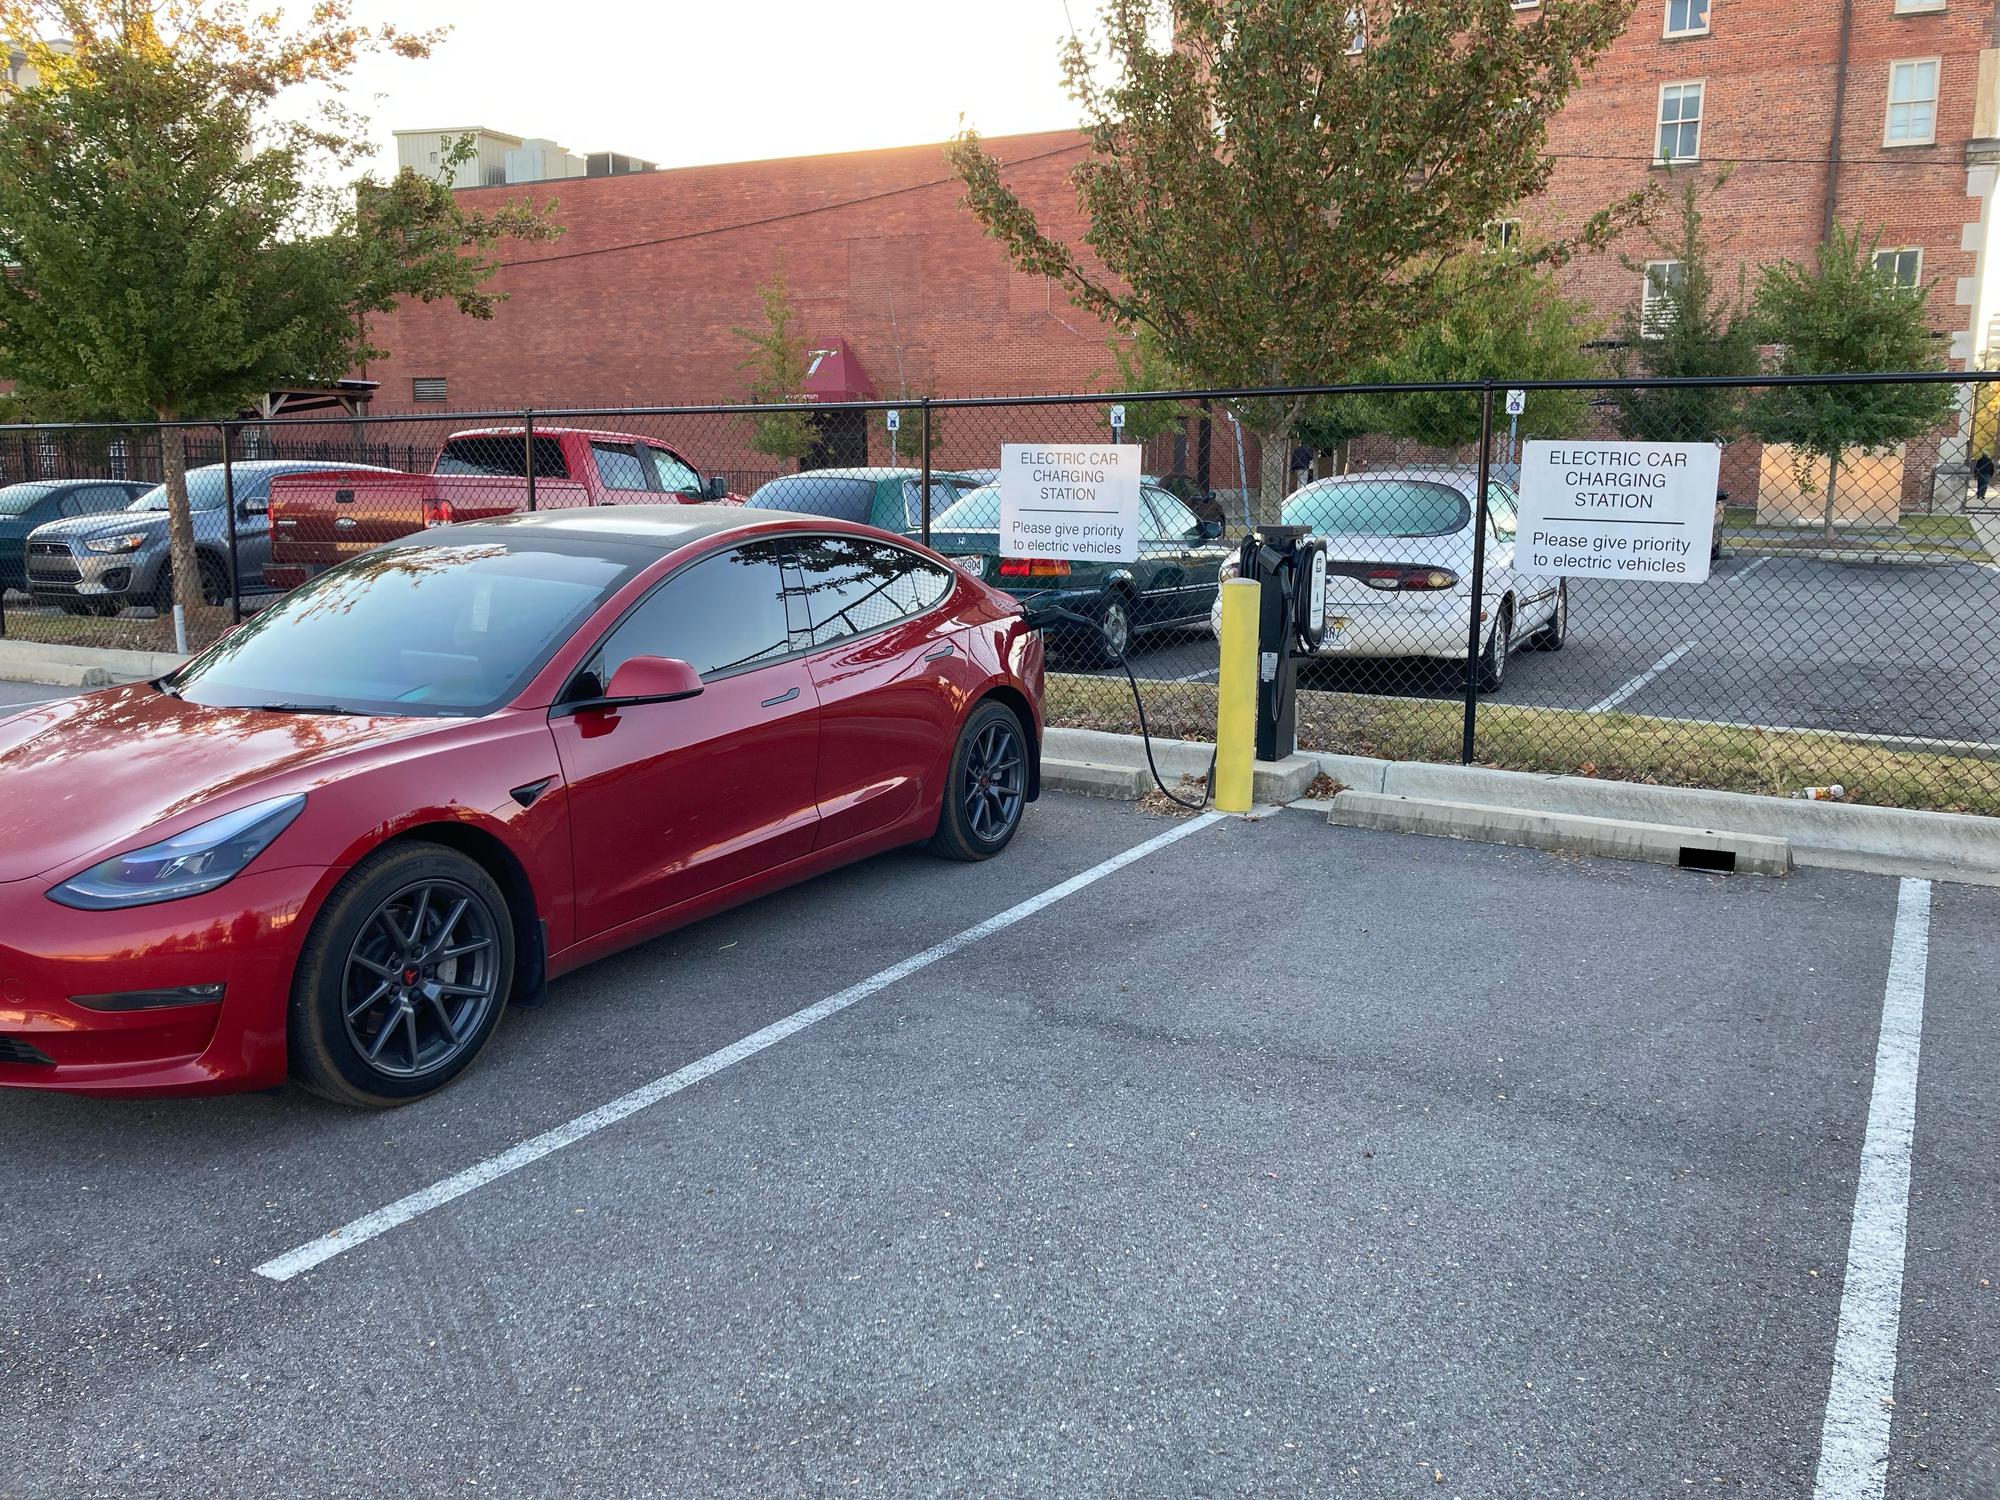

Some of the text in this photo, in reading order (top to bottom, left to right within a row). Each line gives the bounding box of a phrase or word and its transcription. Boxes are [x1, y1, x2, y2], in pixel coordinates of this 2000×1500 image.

[1021, 452, 1119, 465] ELECTRIC CAR
[1549, 450, 1687, 467] ELECTRIC CAR
[1033, 470, 1104, 483] CHARGING
[1565, 471, 1666, 488] CHARGING
[1040, 487, 1096, 501] STATION
[1574, 492, 1653, 508] STATION
[1012, 521, 1124, 540] Please give priority
[1013, 539, 1121, 555] to electric vehicles
[1533, 531, 1691, 556] Please give priority
[1533, 553, 1686, 573] to electric vehicles
